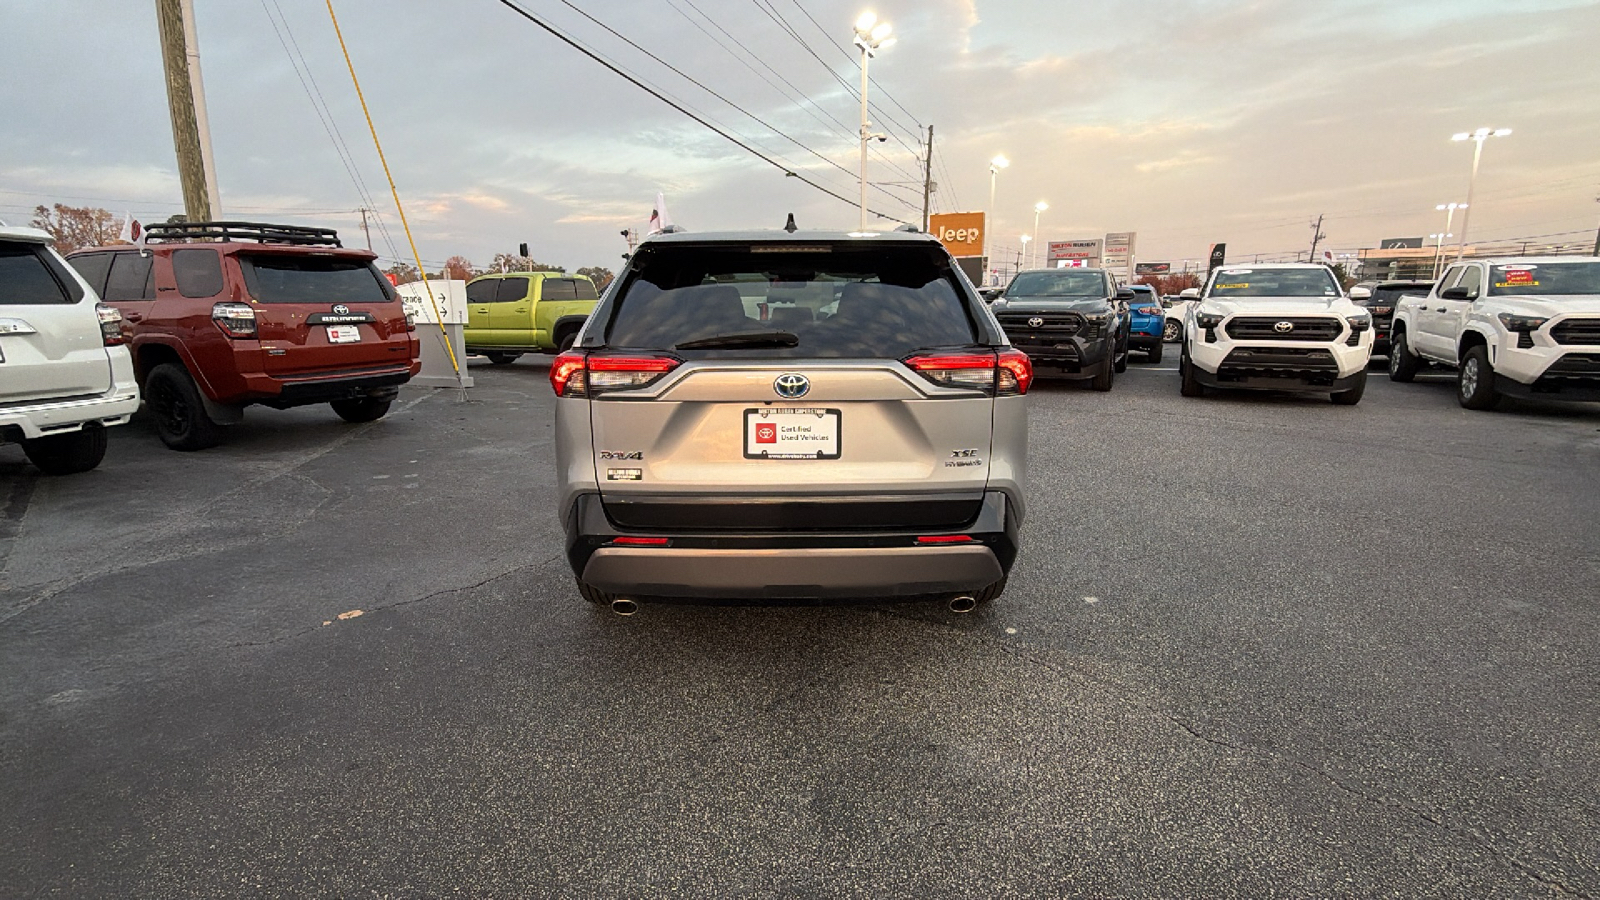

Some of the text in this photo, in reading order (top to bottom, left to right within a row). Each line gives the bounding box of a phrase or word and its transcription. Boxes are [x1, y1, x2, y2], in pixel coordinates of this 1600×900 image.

[934, 226, 979, 244] Jeep
[600, 450, 643, 460] RAV4
[951, 448, 978, 458] XSE
